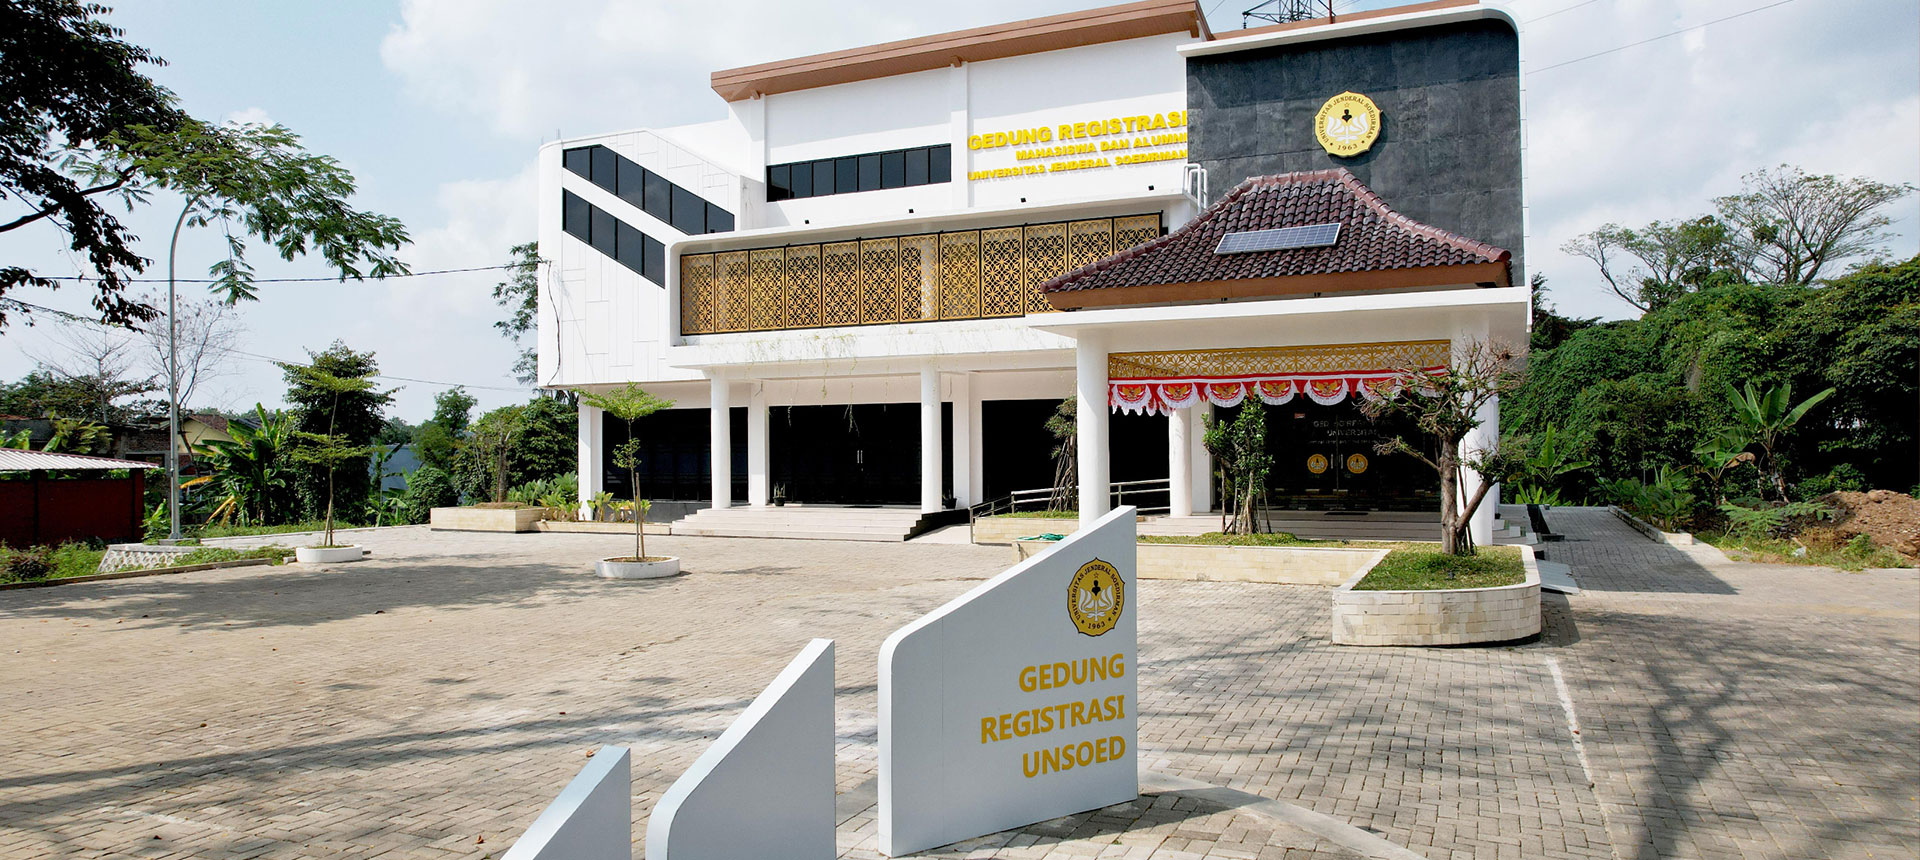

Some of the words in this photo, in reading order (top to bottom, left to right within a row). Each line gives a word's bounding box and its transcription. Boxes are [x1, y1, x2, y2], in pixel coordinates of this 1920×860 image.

[1333, 95, 1365, 106] JENDERAL
[968, 127, 1051, 150] GEDUNG
[1058, 110, 1187, 141] REGISTRASI
[1016, 142, 1096, 160] MAHASISWA
[1100, 138, 1129, 152] DAN
[1133, 132, 1187, 148] ALUMNI
[1337, 143, 1358, 151] 1963
[968, 164, 1045, 181] UNIVERSITAS
[1048, 157, 1110, 173] JENDERAL
[1115, 149, 1187, 166] SOEDIRMAN
[1071, 573, 1085, 621] UNIVERSITAS
[1084, 564, 1111, 576] JENDERAL
[1088, 621, 1106, 630] 1963
[1019, 653, 1125, 692] GEDUNG
[981, 695, 1125, 744] REGISTRASI
[1023, 736, 1126, 778] UNSOED
